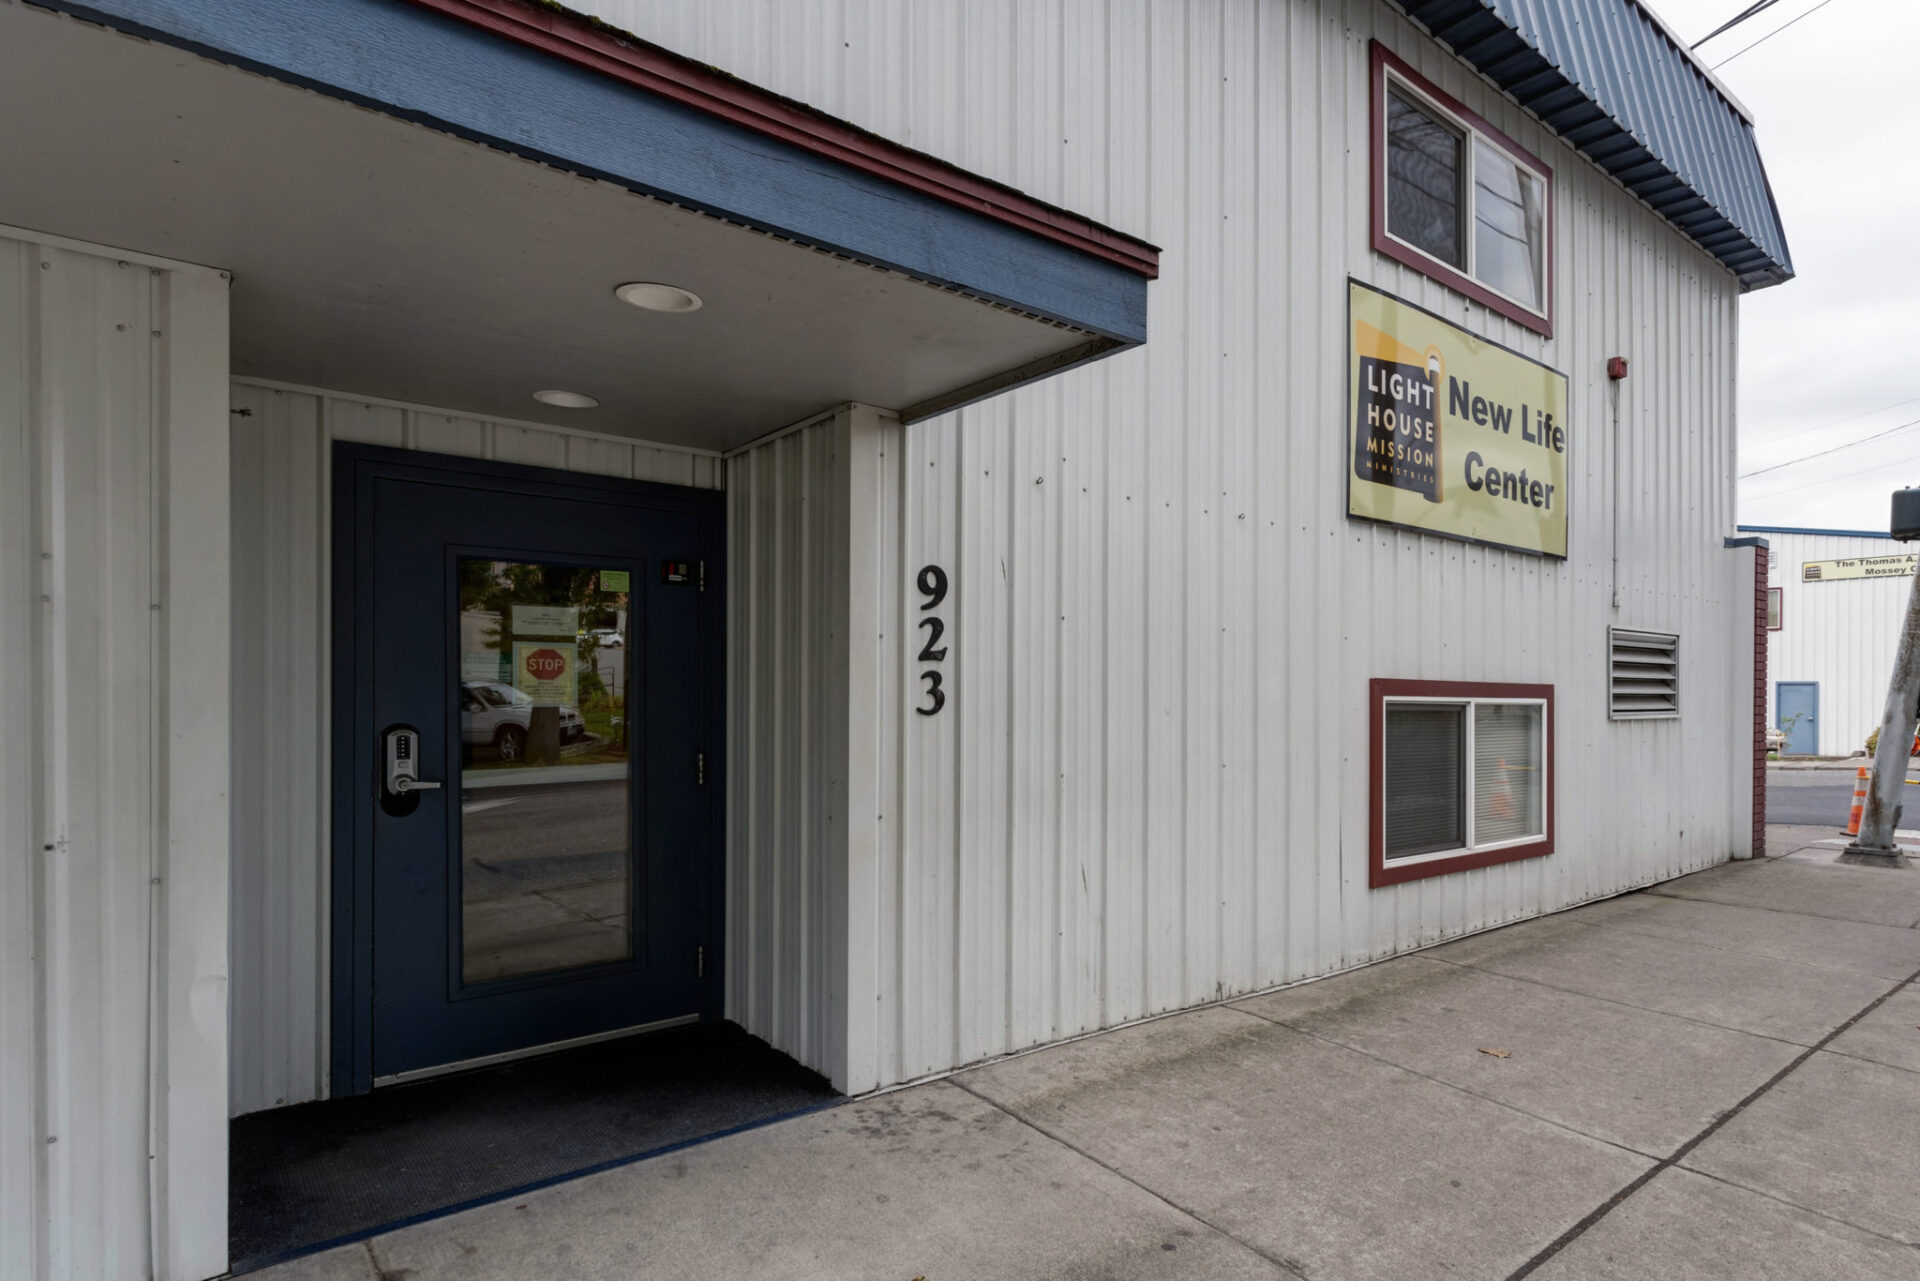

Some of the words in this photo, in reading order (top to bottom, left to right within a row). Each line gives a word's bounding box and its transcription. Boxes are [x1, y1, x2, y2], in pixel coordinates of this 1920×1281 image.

[1367, 365, 1434, 409] LIGHT
[1367, 403, 1434, 442] HOUSE
[1449, 375, 1512, 434] New
[1522, 404, 1565, 453] Life
[1366, 437, 1434, 467] MISSION
[1366, 461, 1434, 484] MINISTRIES
[1464, 451, 1554, 510] Center
[1859, 557, 1902, 566] Thomas
[1906, 555, 1917, 563] A.
[1865, 567, 1906, 576] Mossey
[916, 565, 948, 716] 923
[528, 658, 563, 671] STOP
